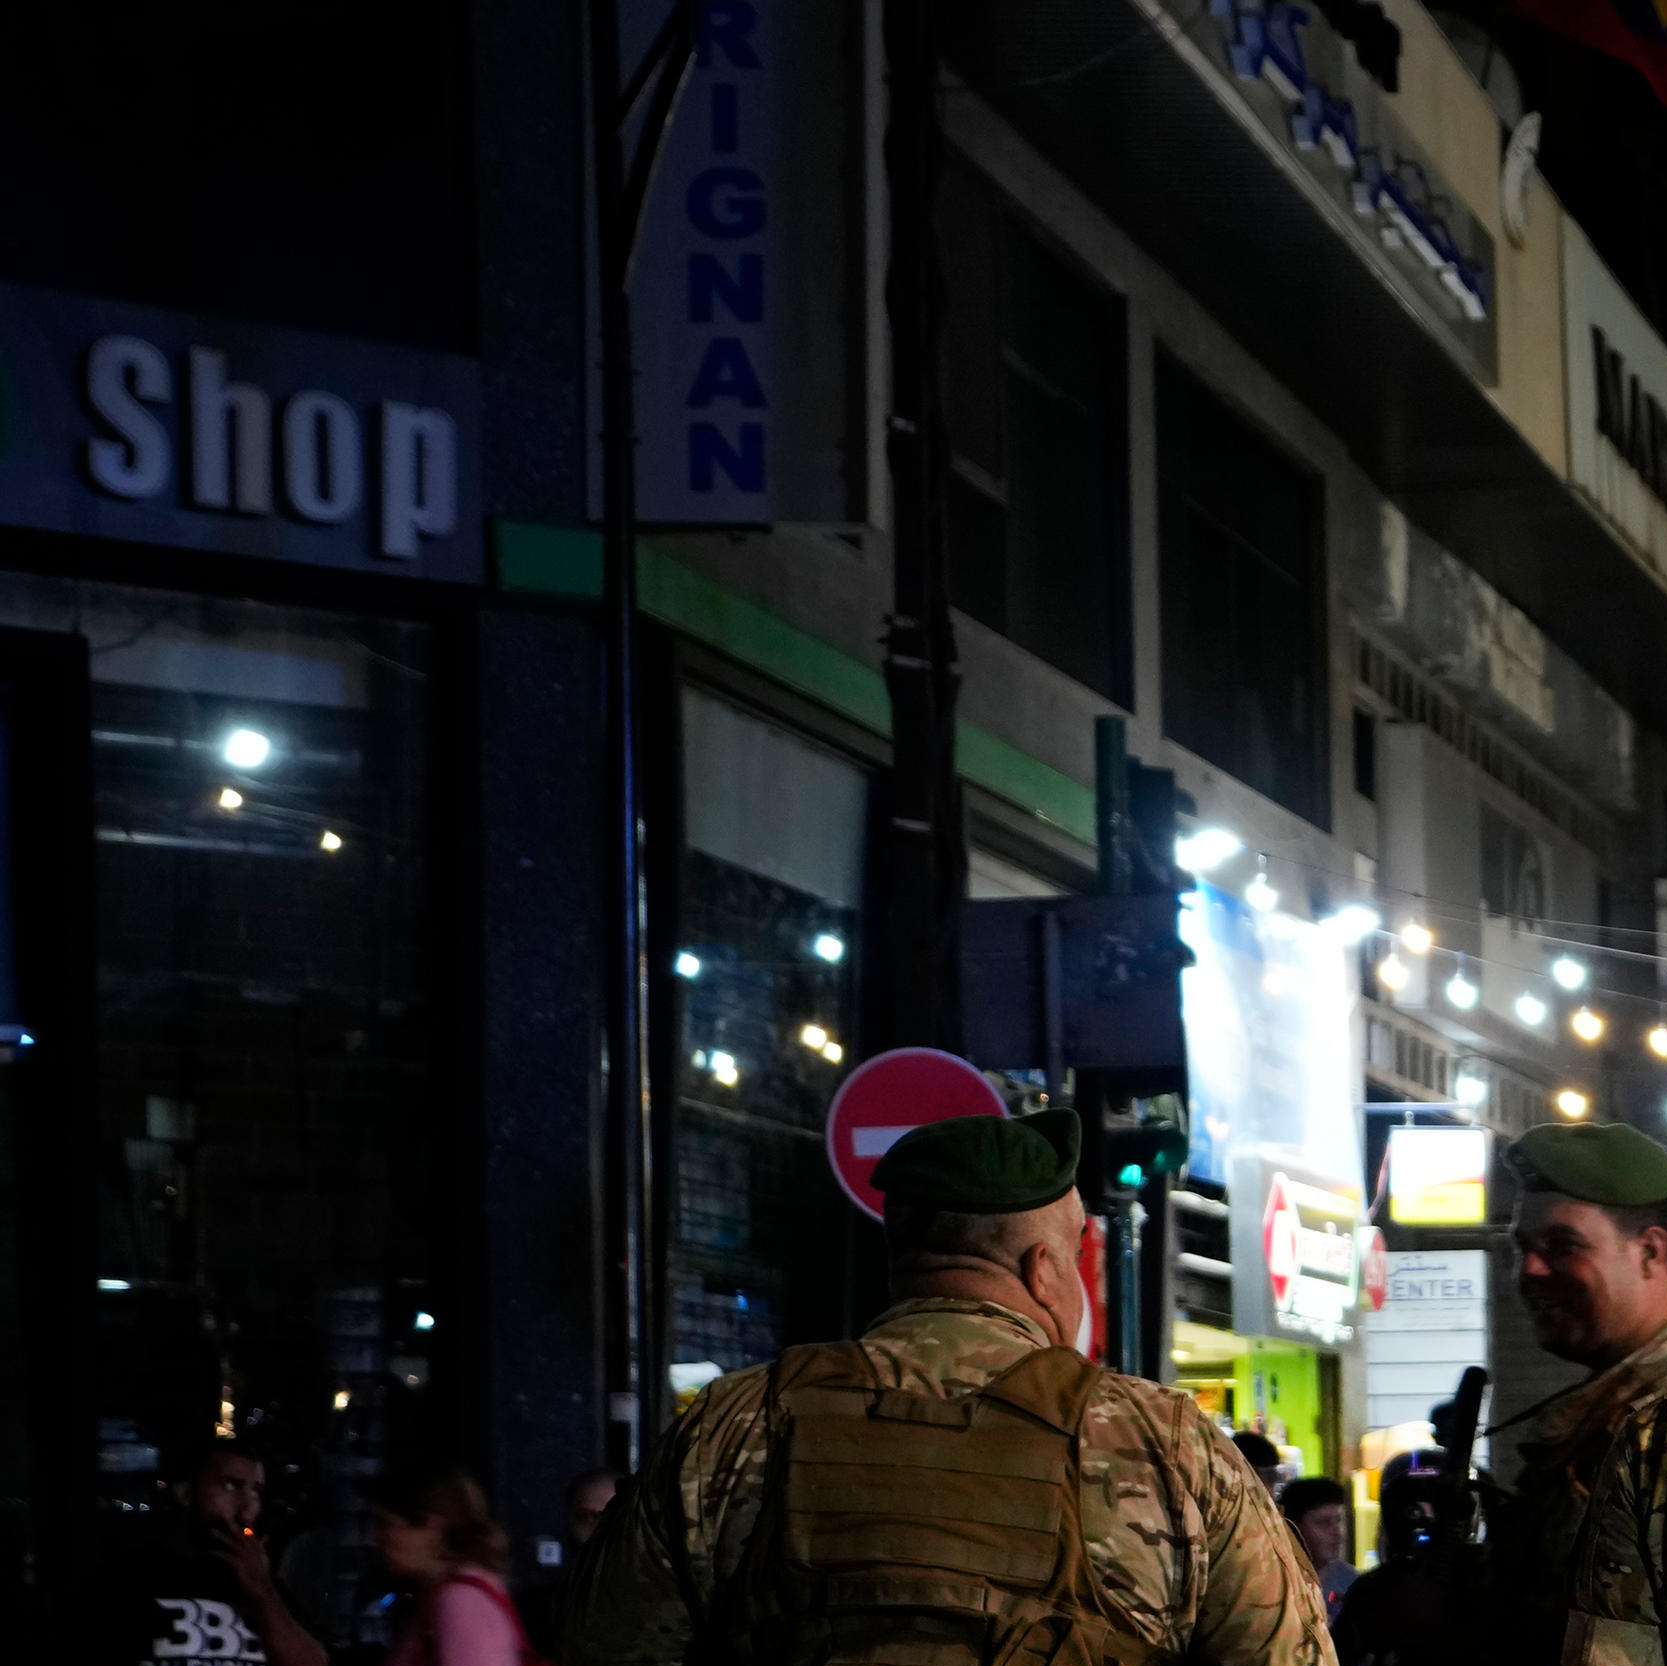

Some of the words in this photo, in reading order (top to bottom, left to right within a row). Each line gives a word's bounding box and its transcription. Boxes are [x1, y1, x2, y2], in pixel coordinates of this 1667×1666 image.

[685, 0, 767, 493] RIGNAN
[86, 334, 458, 560] Shop
[1386, 1279, 1474, 1297] ENTER
